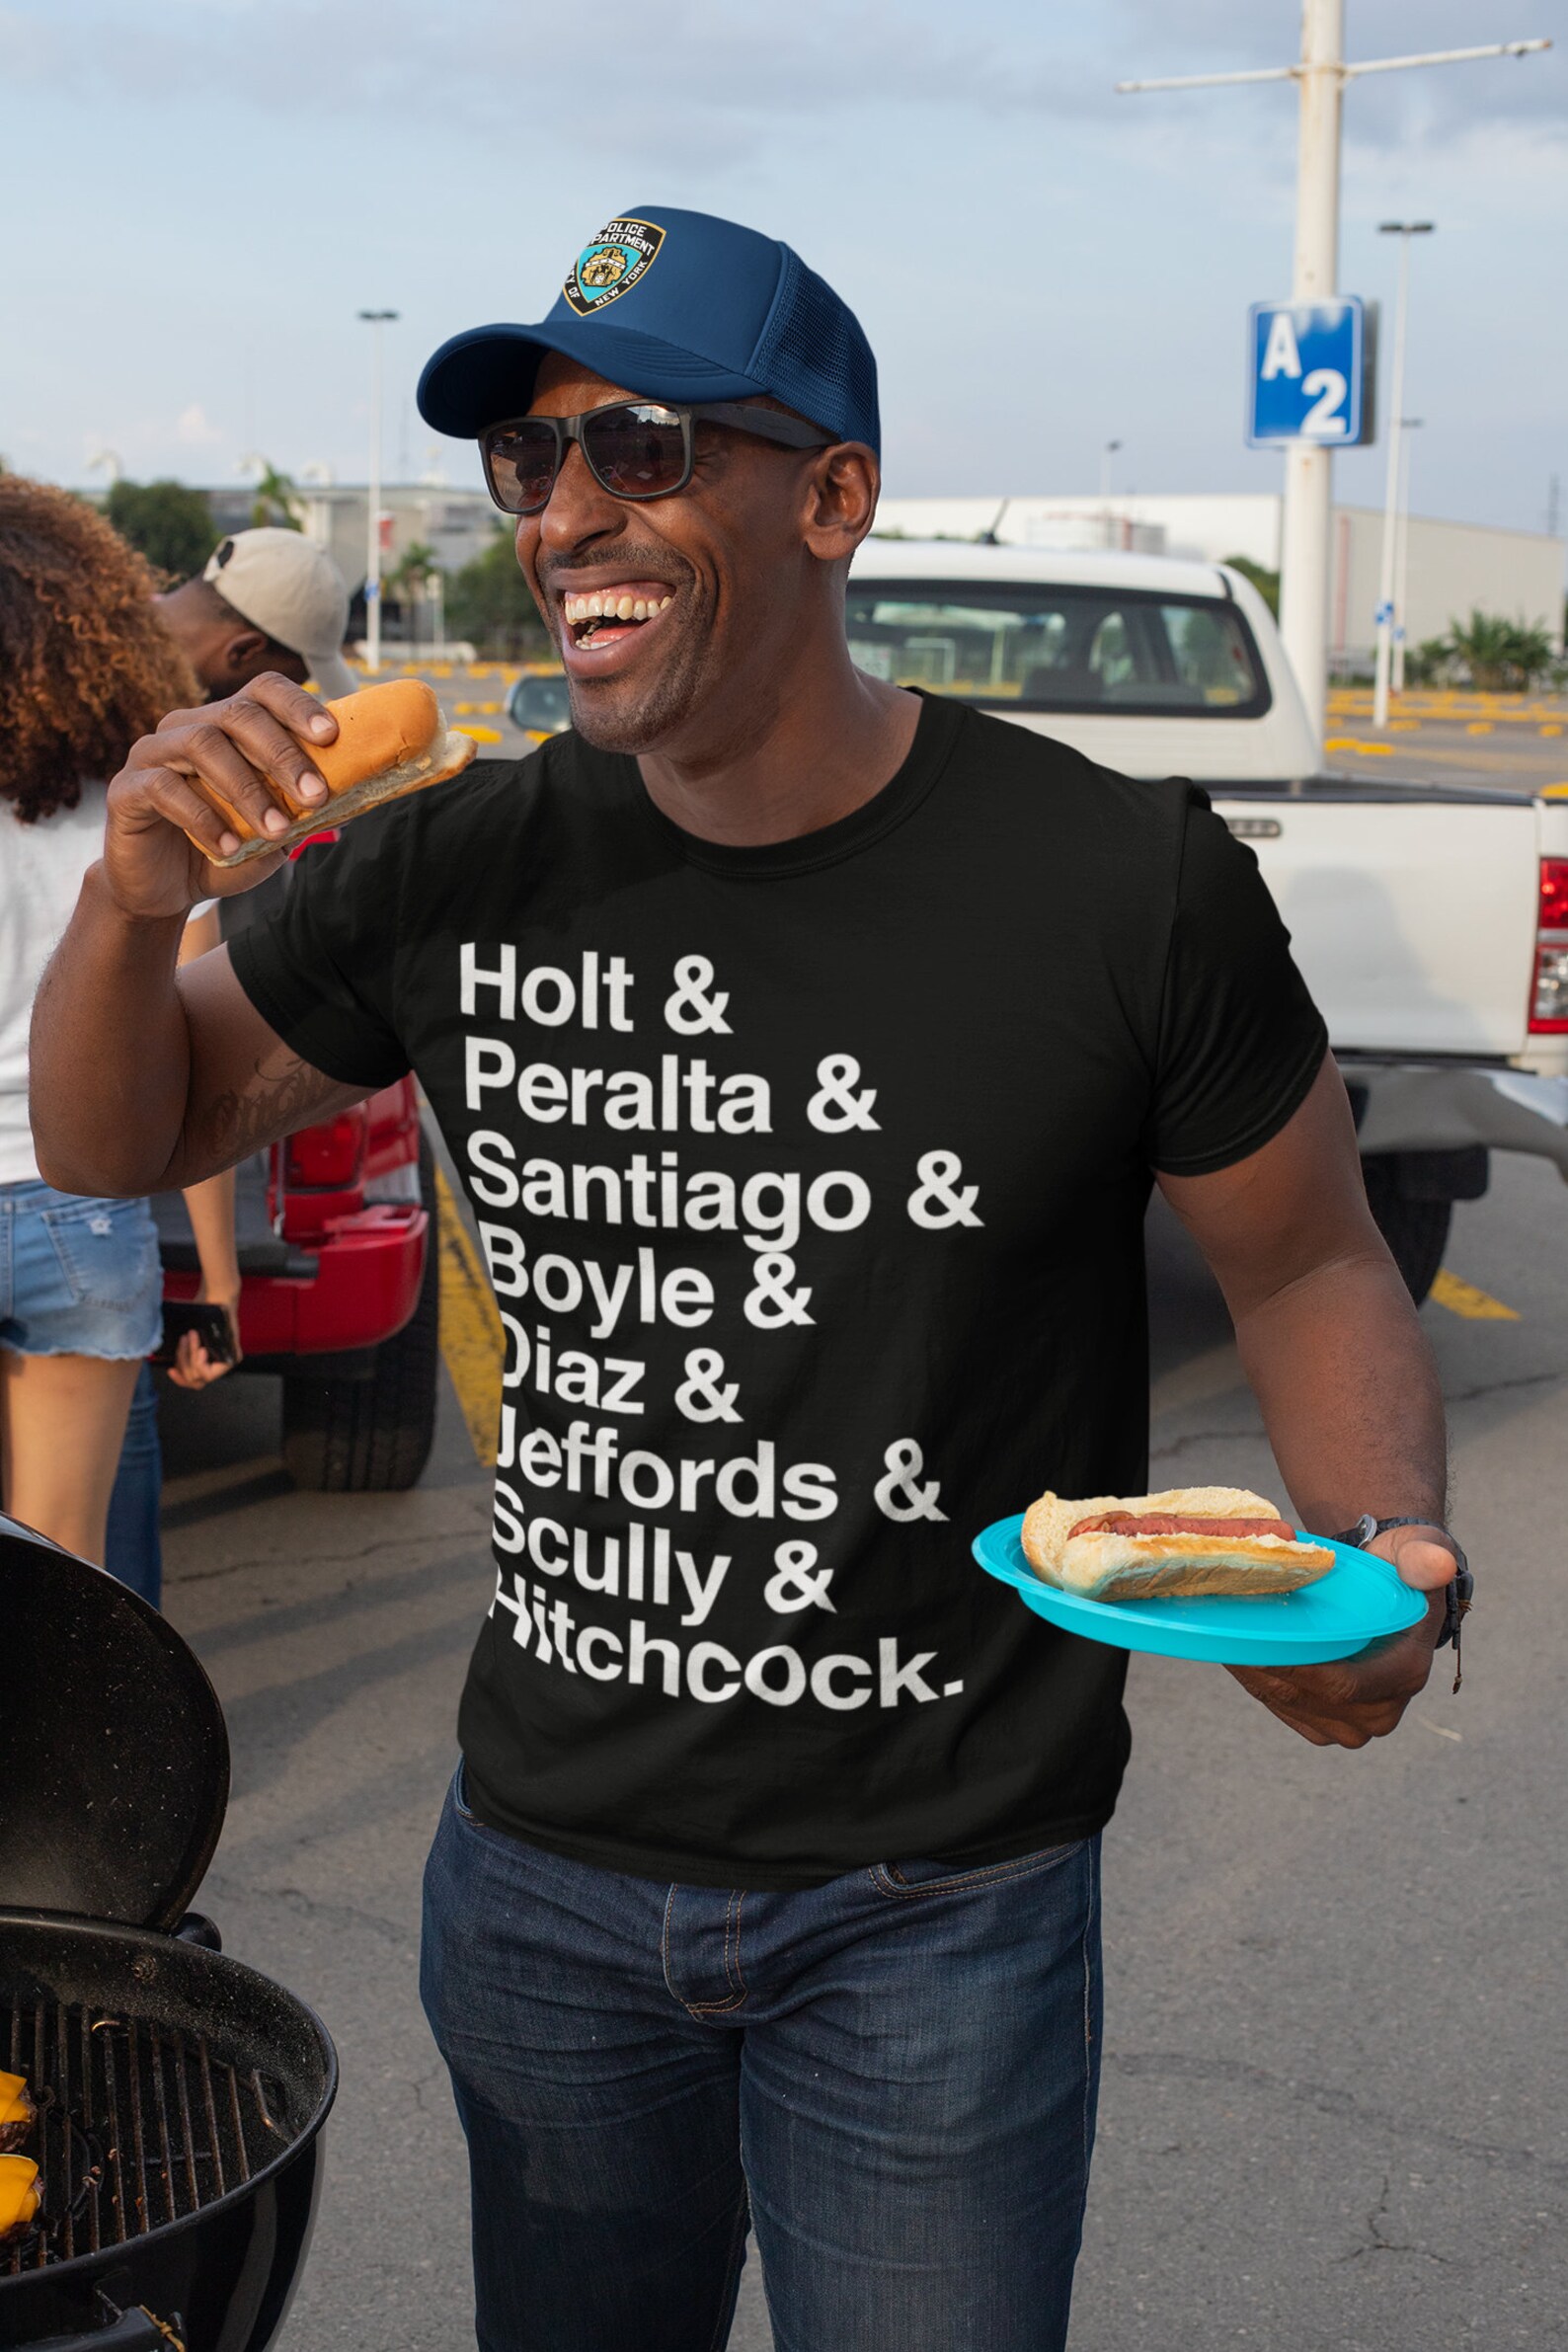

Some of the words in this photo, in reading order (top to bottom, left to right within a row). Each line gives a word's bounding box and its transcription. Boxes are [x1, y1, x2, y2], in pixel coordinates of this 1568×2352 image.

[604, 222, 648, 238] OLICE
[568, 286, 581, 298] OF
[594, 286, 620, 306] NEW
[622, 261, 648, 285] YORK
[1260, 312, 1302, 381] A
[1299, 368, 1347, 435] 2
[460, 942, 635, 1033] Holt
[664, 954, 734, 1036] &
[465, 1035, 773, 1135] Peralta
[806, 1053, 882, 1134] &
[467, 1130, 872, 1253] Santiago
[906, 1149, 984, 1229] &
[478, 1220, 715, 1339] Boyle
[743, 1252, 817, 1330] &
[674, 1347, 745, 1423] &
[496, 1403, 838, 1523] Jeffords
[873, 1438, 950, 1523] &
[491, 1478, 732, 1626] Scully
[763, 1539, 836, 1614] &
[487, 1565, 965, 1710] Hitchcock.
